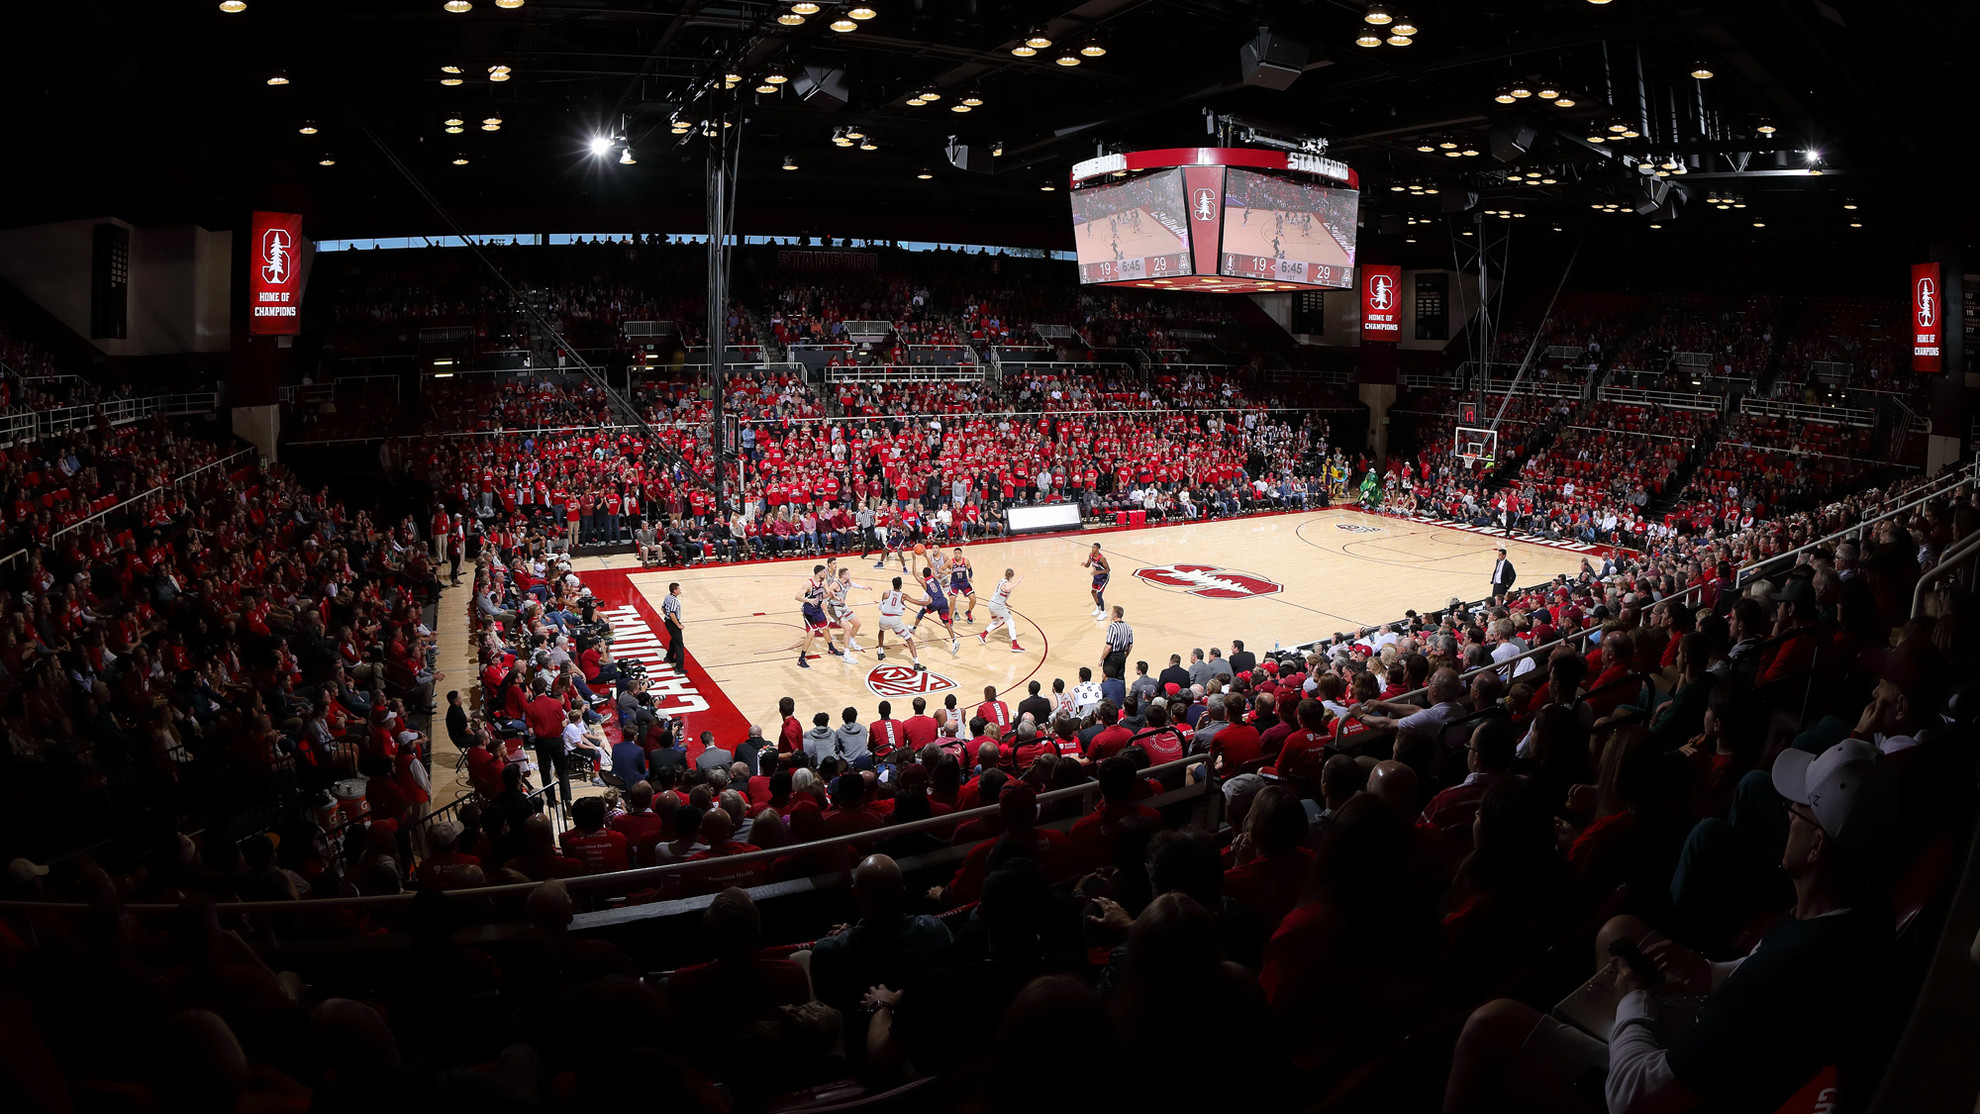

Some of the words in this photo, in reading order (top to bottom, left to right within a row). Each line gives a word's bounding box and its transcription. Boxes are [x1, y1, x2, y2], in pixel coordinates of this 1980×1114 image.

[1287, 152, 1349, 180] STANFORD
[1100, 263, 1111, 275] 19
[1122, 260, 1140, 272] 6:45
[1153, 257, 1167, 271] 29
[1252, 257, 1267, 271] 19
[1281, 262, 1303, 274] 6:45
[1317, 266, 1331, 280] 29
[259, 292, 280, 302] HOME
[281, 292, 291, 302] OF
[254, 306, 296, 317] CHAMPIONS
[1364, 322, 1398, 331] CHAMPIONS
[891, 597, 897, 606] 0
[1061, 700, 1074, 712] 20
[736, 870, 754, 879] Health
